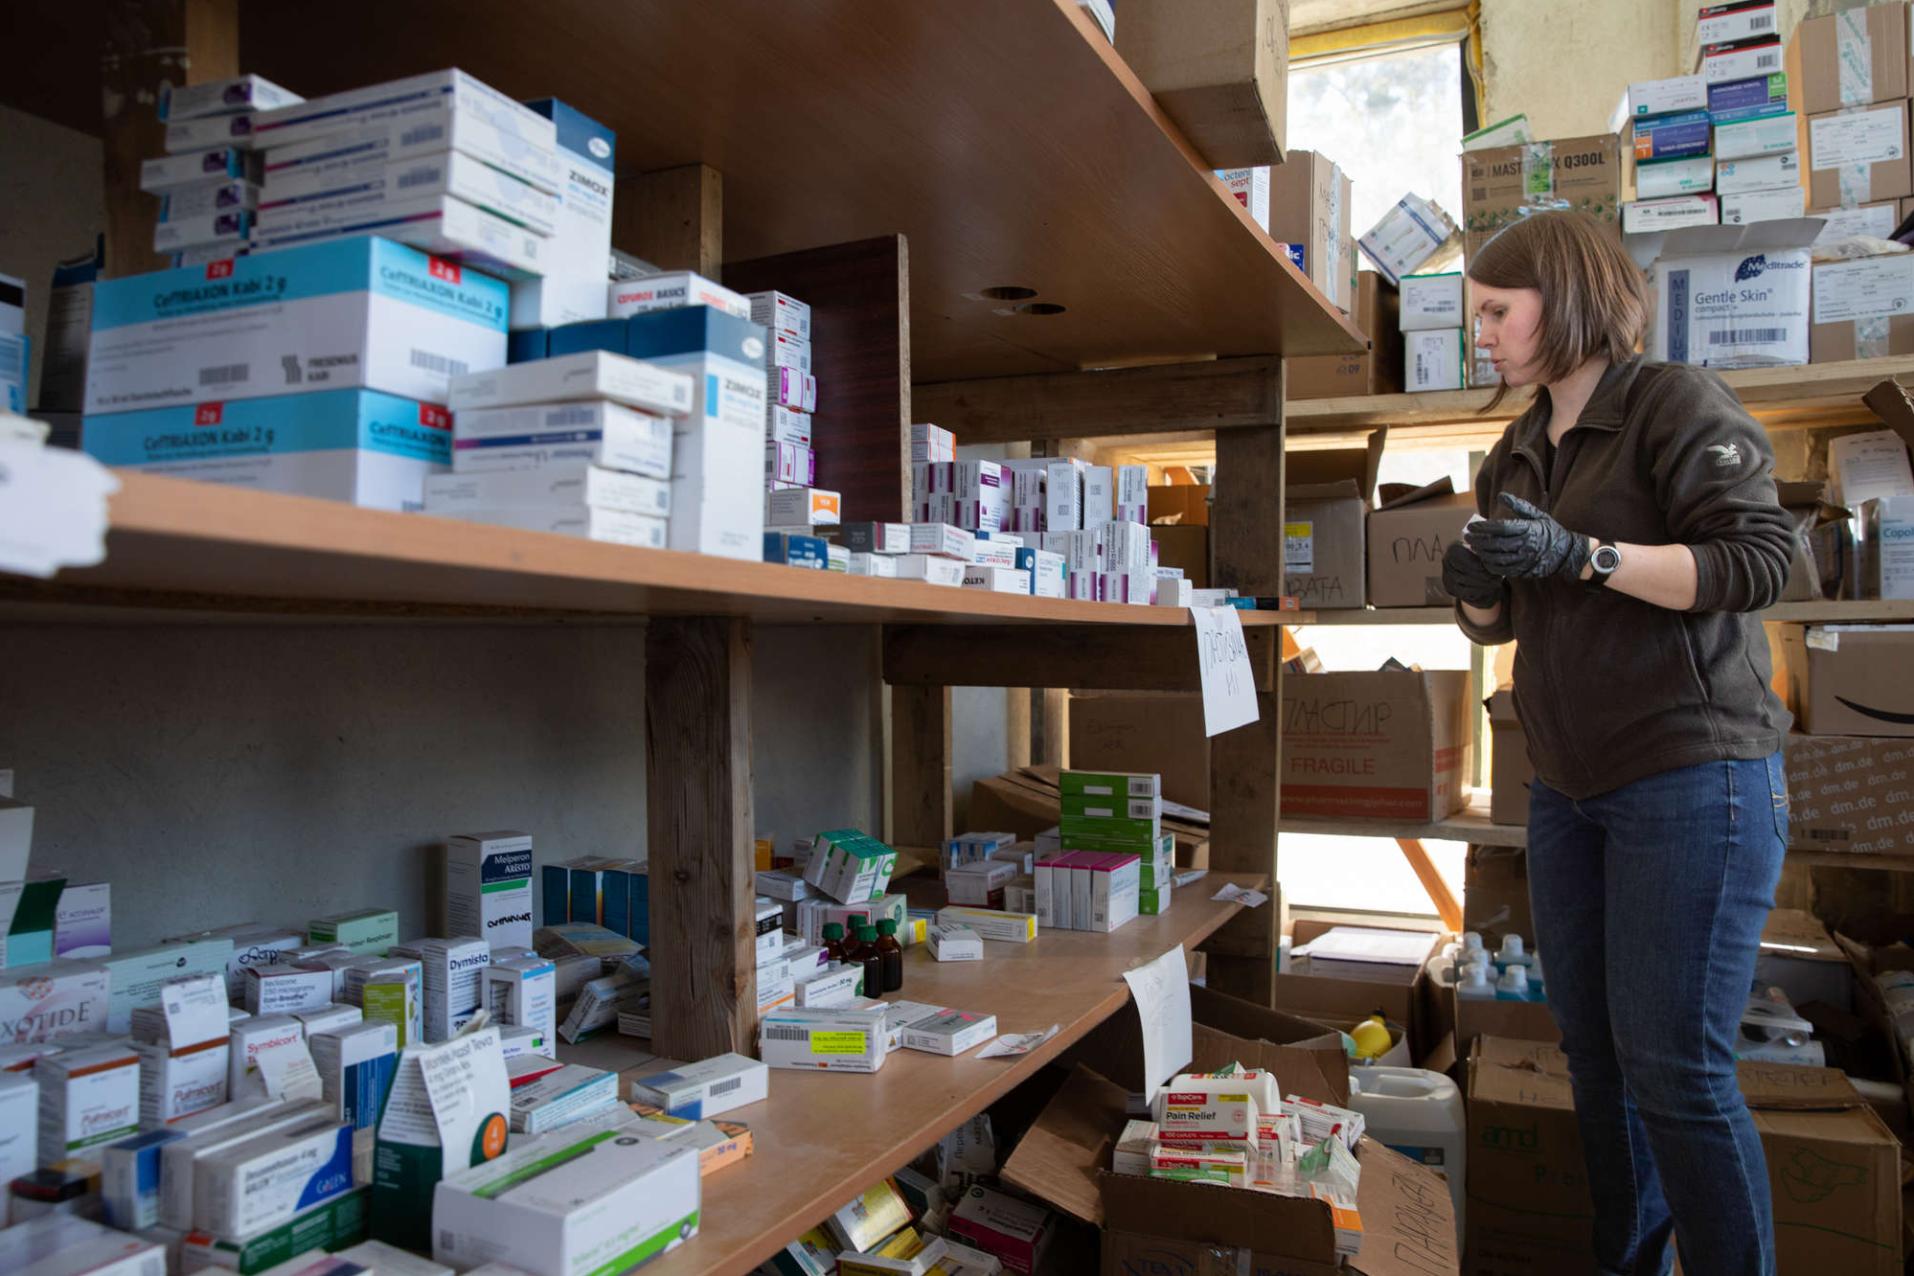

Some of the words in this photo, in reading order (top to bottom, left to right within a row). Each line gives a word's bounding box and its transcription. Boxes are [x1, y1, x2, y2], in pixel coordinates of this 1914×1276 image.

[1564, 152, 1606, 170] Q300L
[569, 170, 609, 196] ZIMOX
[1695, 291, 1736, 305] Gentle
[1290, 757, 1376, 776] FRAGILE
[1835, 757, 1873, 773] dm.de
[1820, 780, 1859, 796] dm.de
[1867, 771, 1906, 786] dm.de
[1830, 796, 1877, 815] dm.de
[1850, 837, 1895, 854] dm.de
[494, 853, 530, 865] Melperon
[450, 953, 489, 971] Dymista
[247, 1034, 297, 1054] Symbicort
[1167, 1111, 1185, 1120] Pain
[1188, 1111, 1217, 1120] Relief
